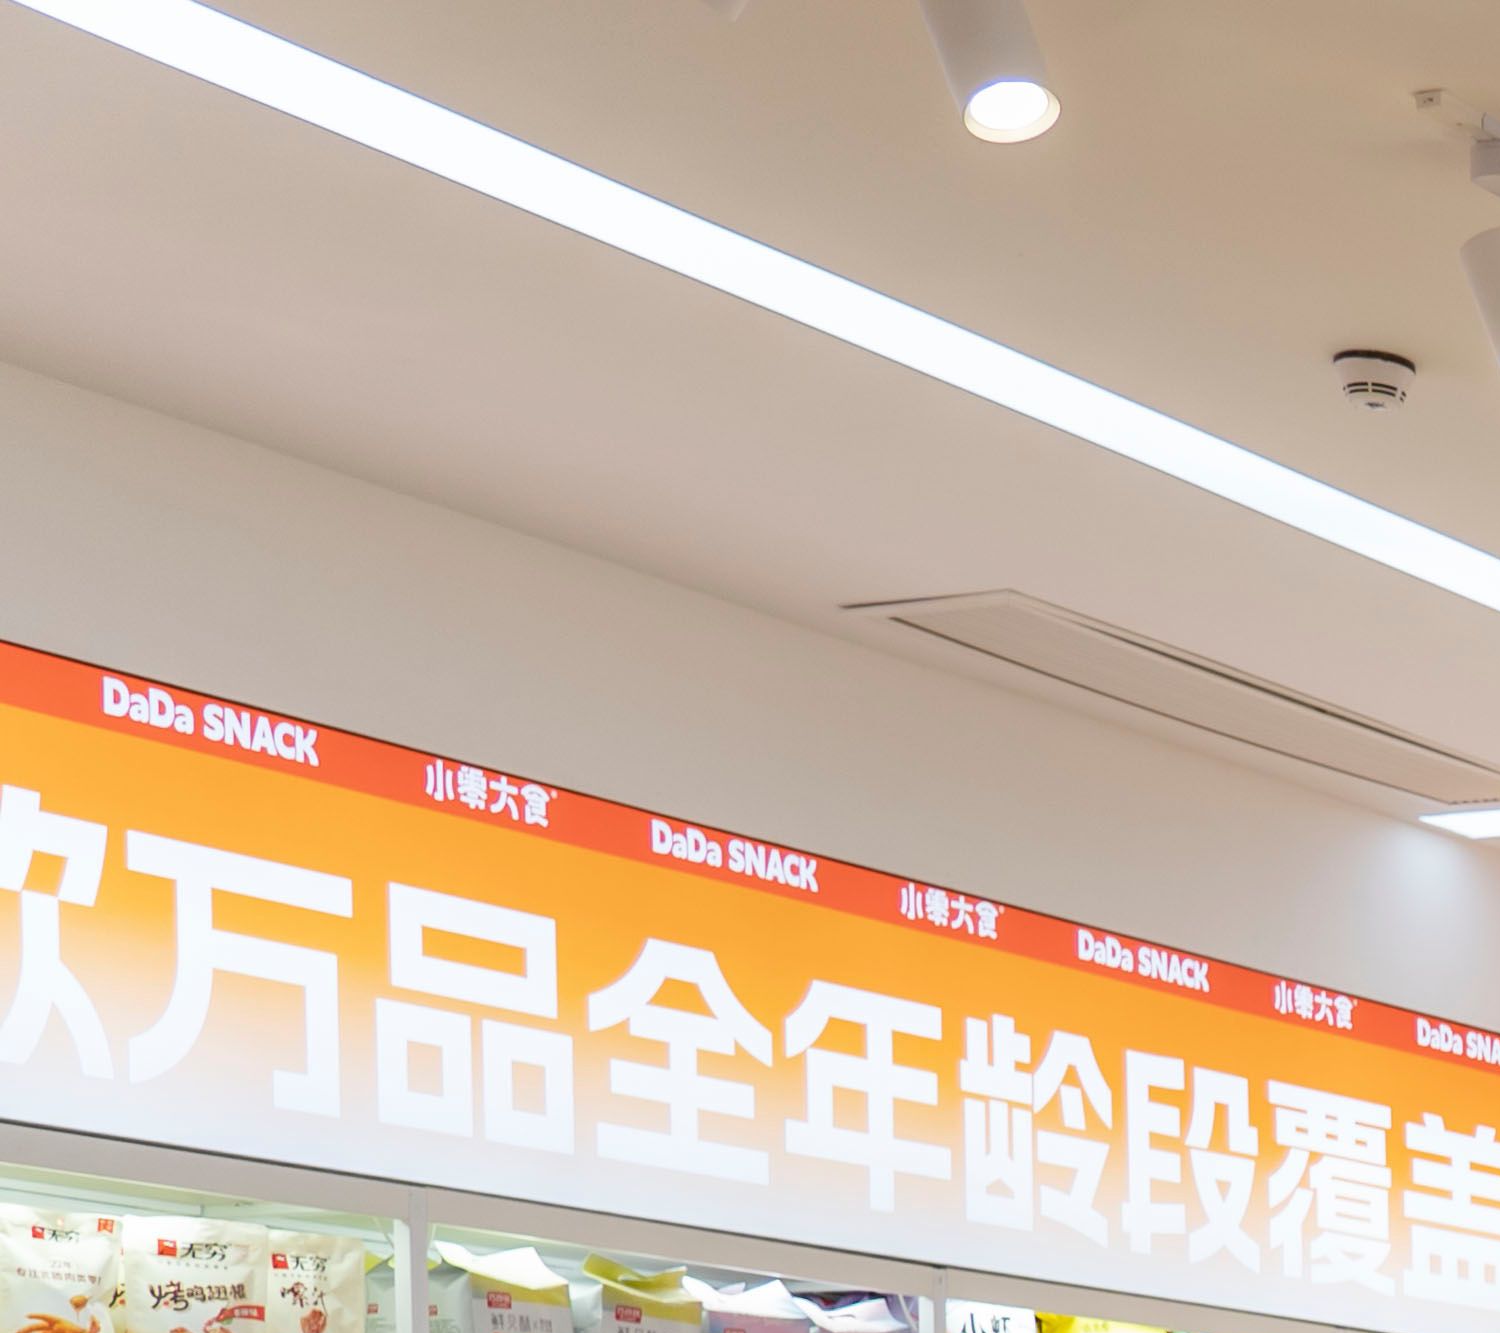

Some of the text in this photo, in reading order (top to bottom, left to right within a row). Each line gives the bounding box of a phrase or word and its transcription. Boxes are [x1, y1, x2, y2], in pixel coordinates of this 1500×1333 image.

[103, 676, 319, 766] DaDa SNACK
[425, 760, 551, 827] 小零大食
[651, 819, 818, 892] DaDa SNACK
[900, 884, 999, 940] 小零大食
[1078, 929, 1209, 991] DaDa SNACK
[1274, 981, 1354, 1030] 小零大食
[1417, 1019, 1462, 1054] DaDa
[182, 1244, 231, 1260] 无穷
[290, 1255, 327, 1272] 无穷
